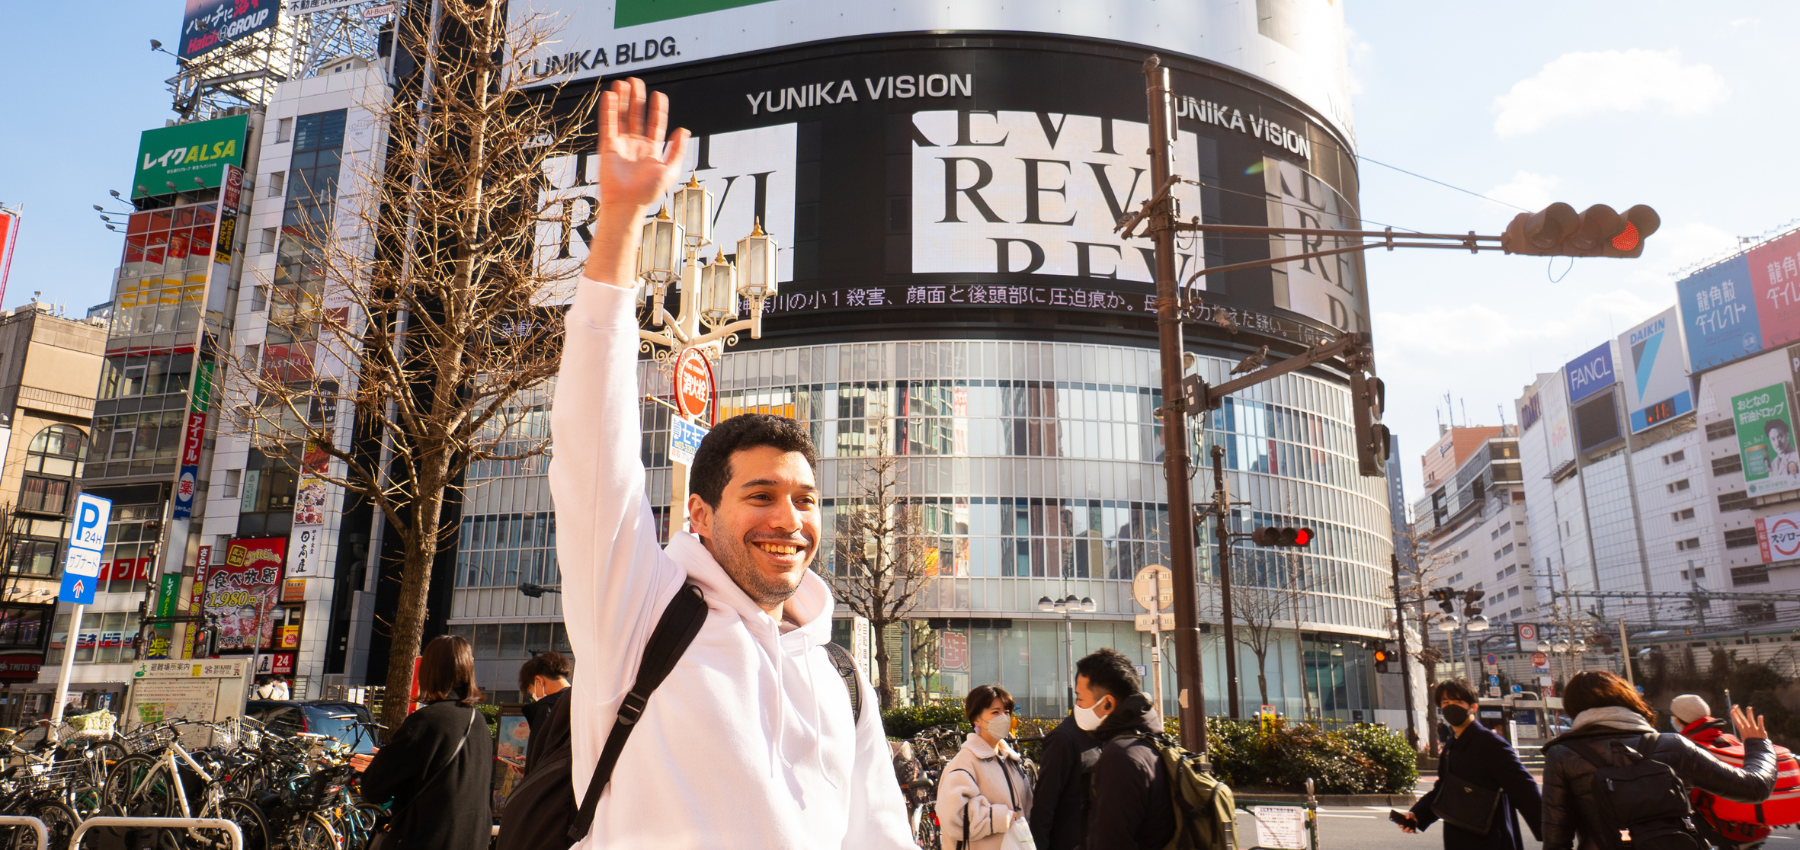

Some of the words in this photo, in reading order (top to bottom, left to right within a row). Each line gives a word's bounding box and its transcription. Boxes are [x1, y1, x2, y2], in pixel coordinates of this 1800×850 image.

[228, 8, 269, 38] GROUP
[518, 47, 610, 76] YUNIKA
[615, 36, 682, 66] BLDG.
[746, 79, 857, 116] YUNIKA
[866, 73, 973, 100] VISION
[1175, 95, 1246, 133] UNIKA
[1250, 113, 1311, 162] VISION
[143, 139, 236, 170] レイクALSA
[218, 220, 228, 245] Table
[225, 218, 235, 251] Cheese
[1696, 279, 1736, 313] 龍角散
[1630, 317, 1665, 346] DAIKIN
[1695, 302, 1746, 336] ダイレクト
[683, 371, 707, 403] 消火栓
[1570, 356, 1611, 391] FANCL
[1737, 393, 1770, 411] おとなの
[1739, 402, 1785, 426] 肝油ドロップ
[186, 415, 203, 462] アイフル
[179, 479, 194, 496] 薬
[76, 501, 100, 541] P
[84, 530, 102, 545] 24H
[212, 567, 279, 590] 食べ放題
[150, 662, 191, 672] 避難場所案内
[277, 655, 290, 667] 24
